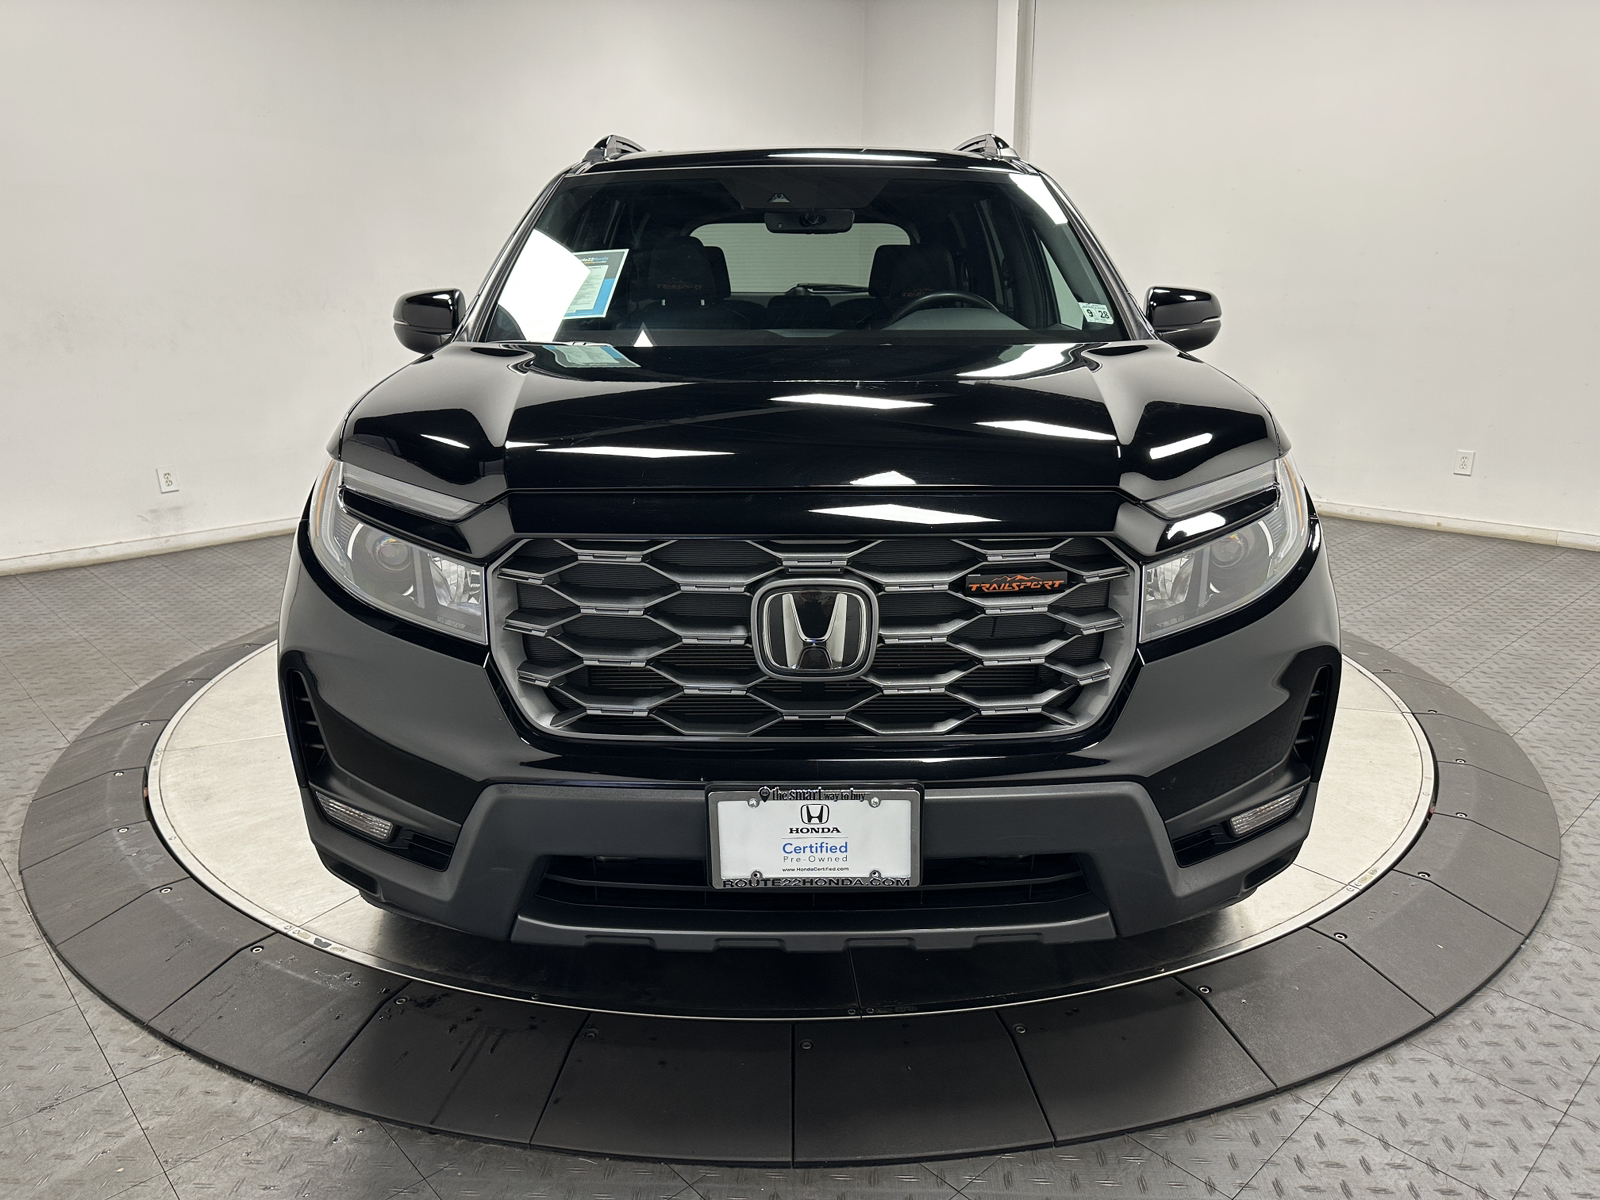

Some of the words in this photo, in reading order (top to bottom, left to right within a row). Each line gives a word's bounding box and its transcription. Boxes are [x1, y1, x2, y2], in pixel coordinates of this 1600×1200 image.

[1086, 309, 1094, 317] 9
[1098, 310, 1110, 319] 28
[968, 580, 1065, 592] TRAILSPORT
[772, 788, 787, 801] the
[789, 786, 823, 801] smart
[823, 793, 840, 802] way
[840, 790, 850, 801] to
[782, 841, 848, 855] Certified
[783, 855, 848, 863] Pre-Owned
[722, 878, 911, 888] ROUTE22HONDA.COM
